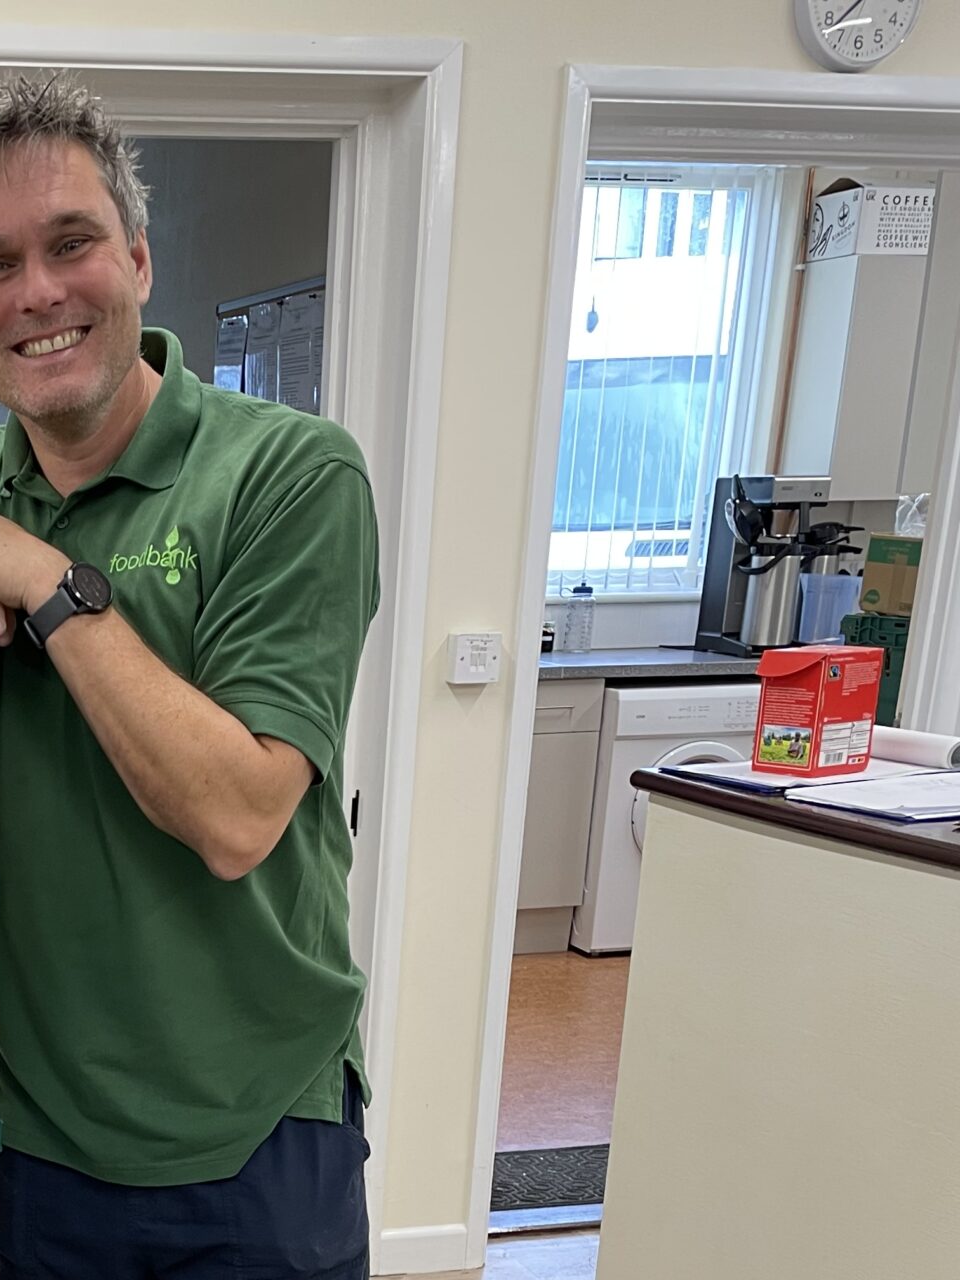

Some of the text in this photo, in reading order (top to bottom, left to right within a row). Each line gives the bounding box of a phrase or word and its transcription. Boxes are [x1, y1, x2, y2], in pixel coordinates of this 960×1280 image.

[888, 12, 898, 26] 4
[853, 35, 864, 50] 6
[873, 28, 883, 44] 5
